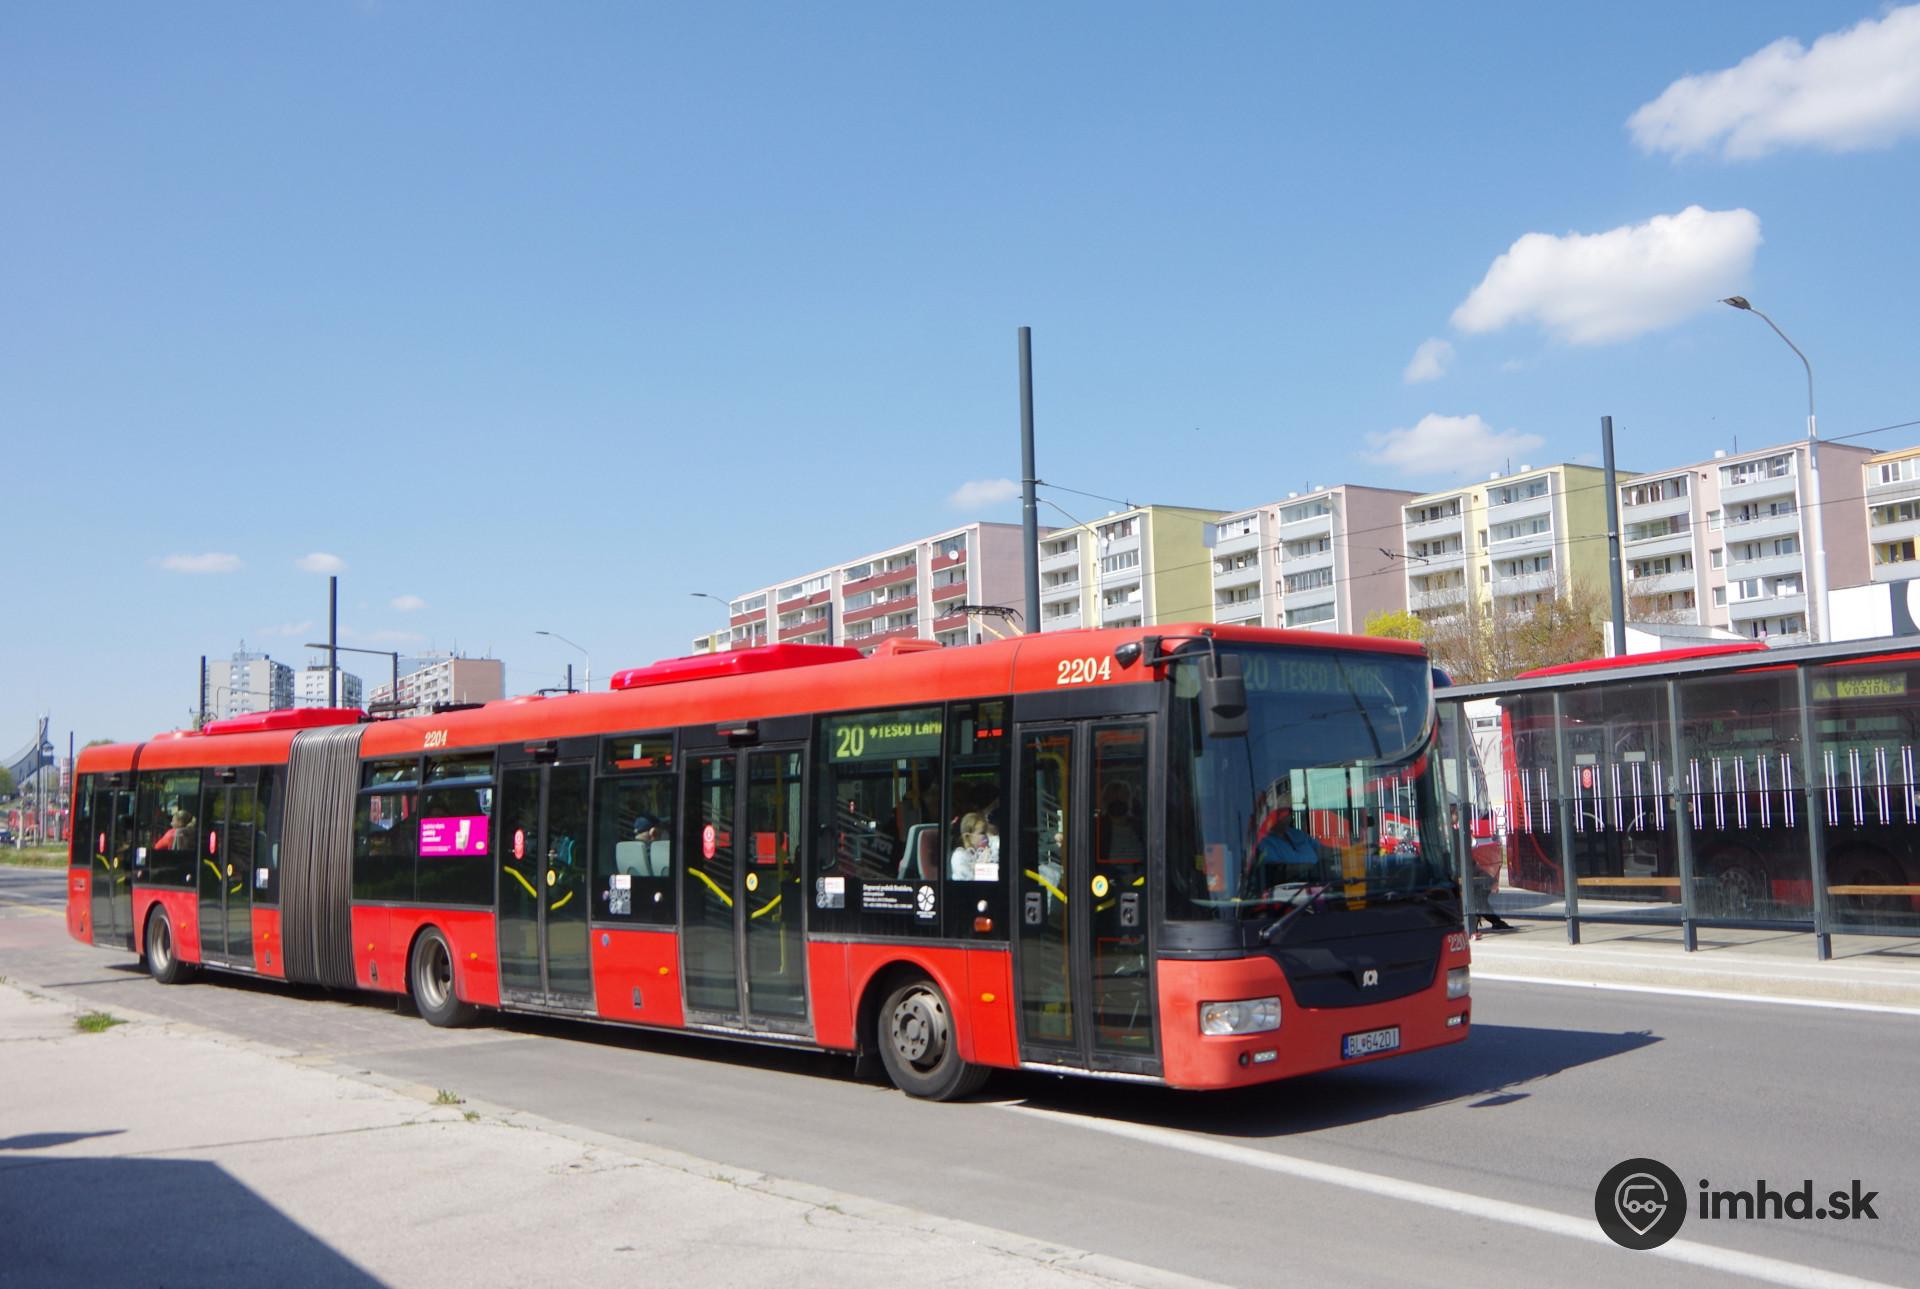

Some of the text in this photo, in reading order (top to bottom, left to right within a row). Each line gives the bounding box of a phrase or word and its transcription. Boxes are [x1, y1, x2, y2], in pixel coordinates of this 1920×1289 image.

[1057, 656, 1111, 685] 2204
[1243, 654, 1269, 690] 20
[424, 729, 448, 748] 2204
[836, 725, 864, 758] 20
[880, 723, 912, 738] TESCO
